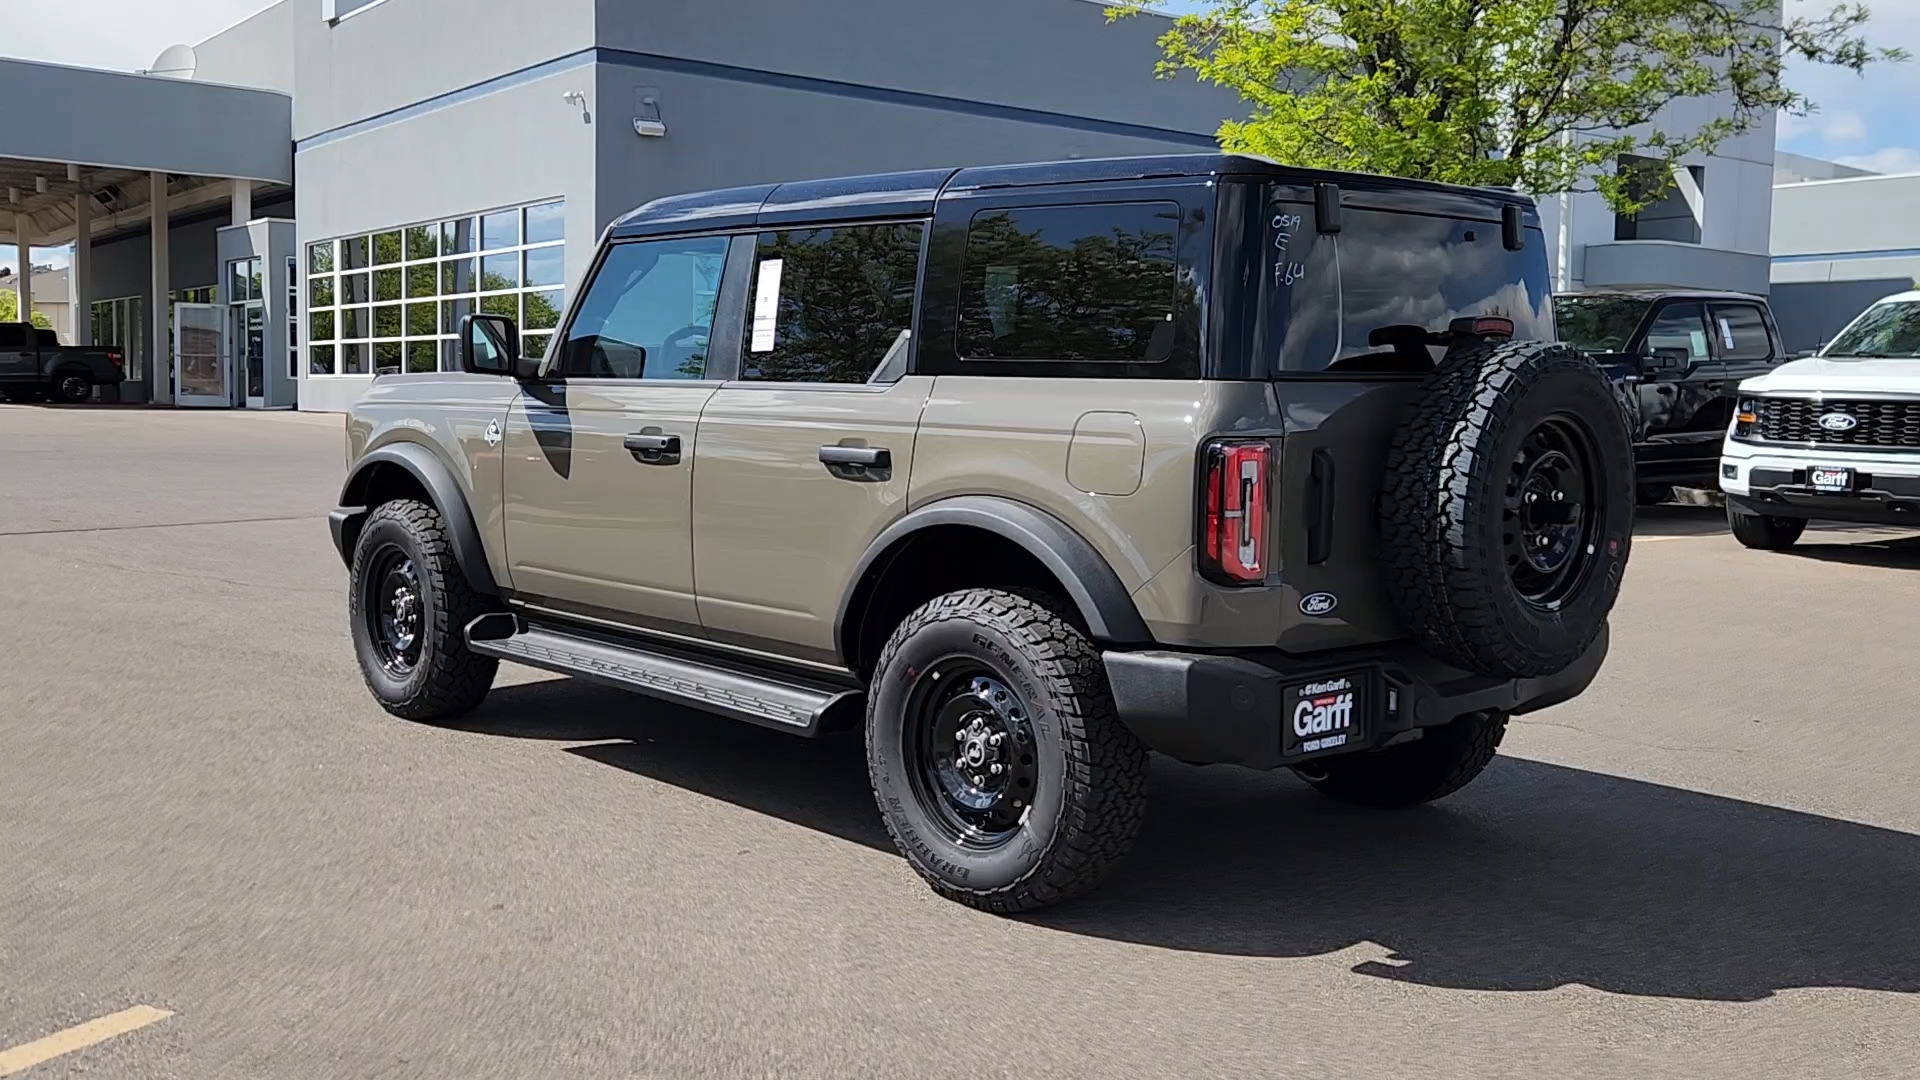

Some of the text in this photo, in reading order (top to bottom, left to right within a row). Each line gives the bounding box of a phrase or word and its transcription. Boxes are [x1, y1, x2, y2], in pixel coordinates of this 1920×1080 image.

[1275, 232, 1291, 250] E
[1811, 470, 1848, 486] Garff
[1306, 595, 1331, 611] Ford
[972, 633, 1051, 741] GENERAL
[1326, 678, 1346, 692] Garff
[1293, 692, 1353, 737] Garff
